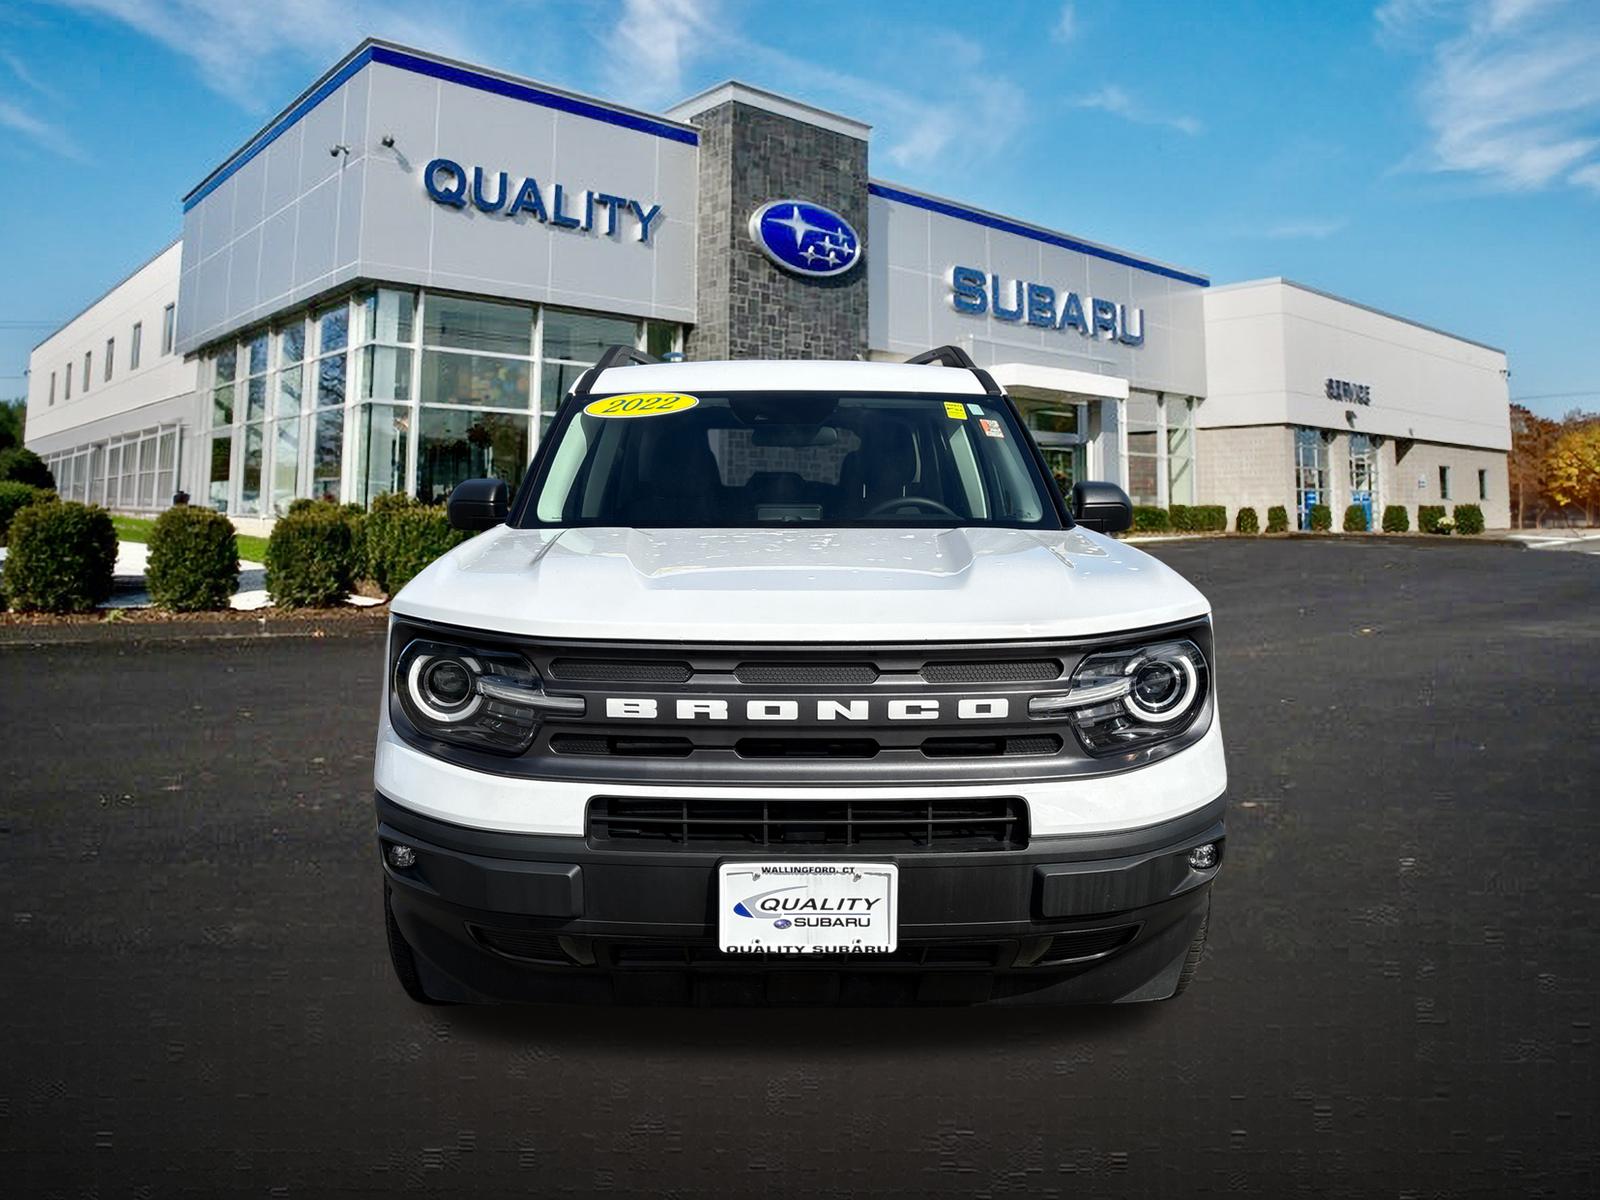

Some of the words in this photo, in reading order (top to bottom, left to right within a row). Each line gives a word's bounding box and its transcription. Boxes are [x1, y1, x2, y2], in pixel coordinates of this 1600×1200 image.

[423, 157, 661, 243] QUALITY
[950, 265, 1145, 347] SUBARU
[602, 396, 680, 413] 2022
[606, 698, 1008, 720] BRONCO
[760, 898, 882, 911] QUALITY
[794, 917, 871, 927] SUBARU
[726, 945, 805, 953] QUALITY
[812, 945, 889, 953] SUBARU
